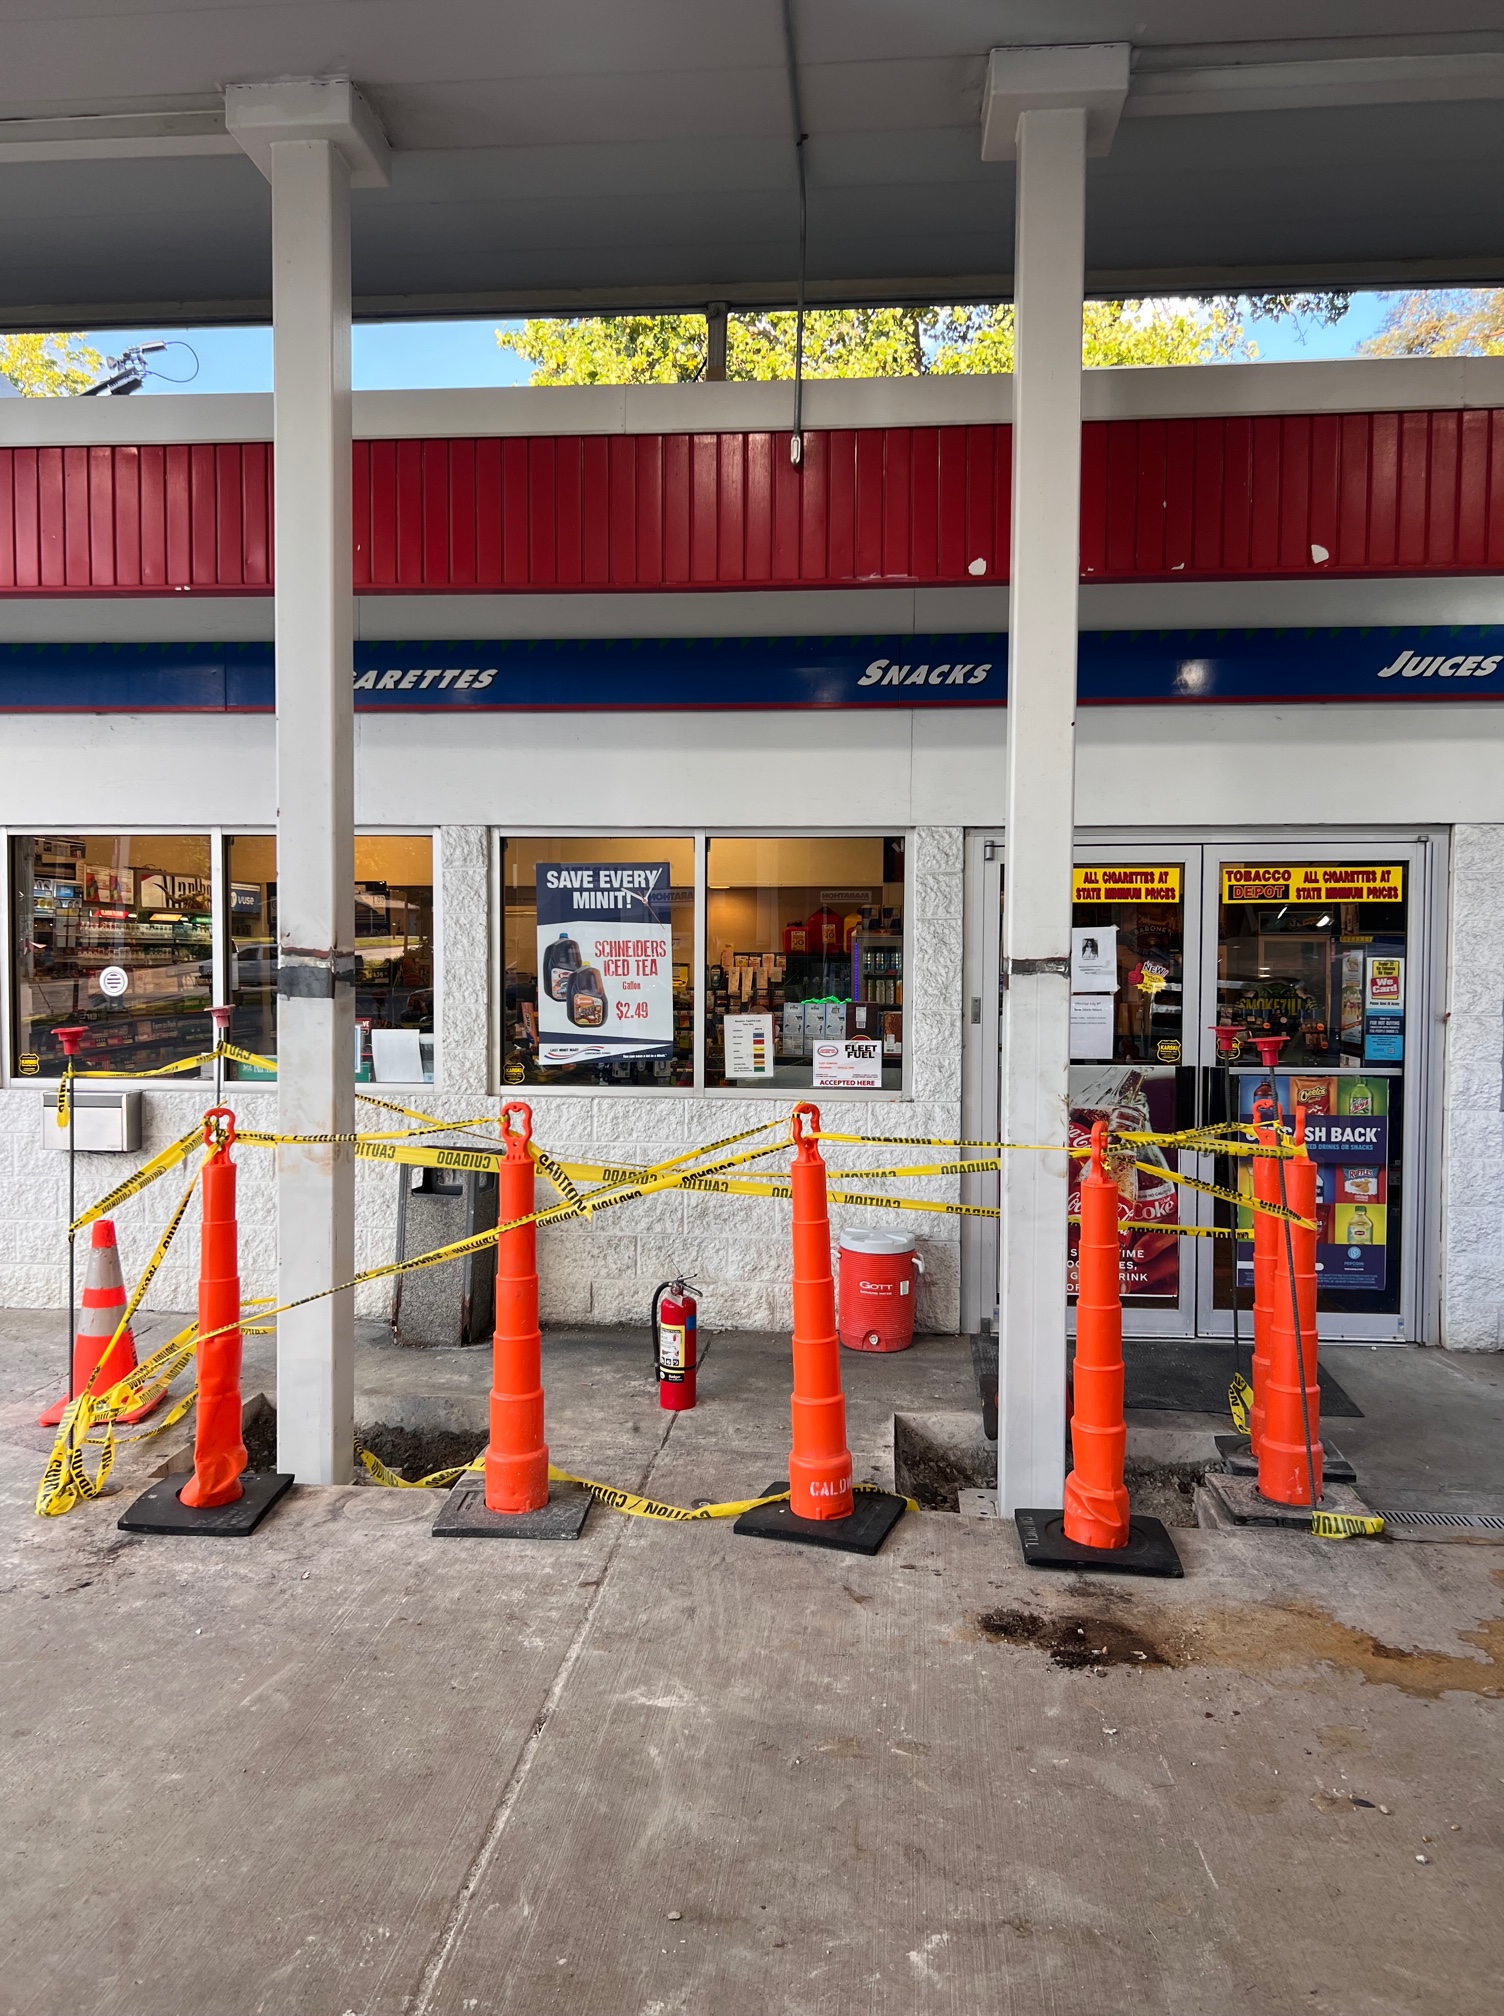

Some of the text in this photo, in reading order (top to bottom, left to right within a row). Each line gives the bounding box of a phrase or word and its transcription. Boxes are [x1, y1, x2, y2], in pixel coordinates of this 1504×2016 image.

[1377, 651, 1503, 677] JUICES
[352, 669, 498, 689] ARETTES
[857, 659, 992, 685] SNACKS
[547, 870, 658, 888] SAVE EVERY
[1083, 871, 1169, 884] ALL CIGARETTES AT
[1226, 870, 1291, 882] TOBACCO
[1304, 870, 1391, 884] ALL CIGARETTES AT
[1076, 887, 1176, 900] STATE MINIMUM PRICES
[1233, 885, 1284, 898] DEPOT
[1296, 886, 1398, 899] STATE MINIMUM PRICES
[573, 892, 631, 909] MINIT!
[594, 940, 666, 957] SCHNEIDERS
[603, 959, 658, 976] ICED TEA
[622, 981, 641, 990] Gallon
[1372, 984, 1397, 993] Card
[1376, 978, 1393, 986] We
[616, 1000, 648, 1020] $2.49
[538, 1153, 586, 1213] CAUTION
[860, 1281, 893, 1290] GOTT
